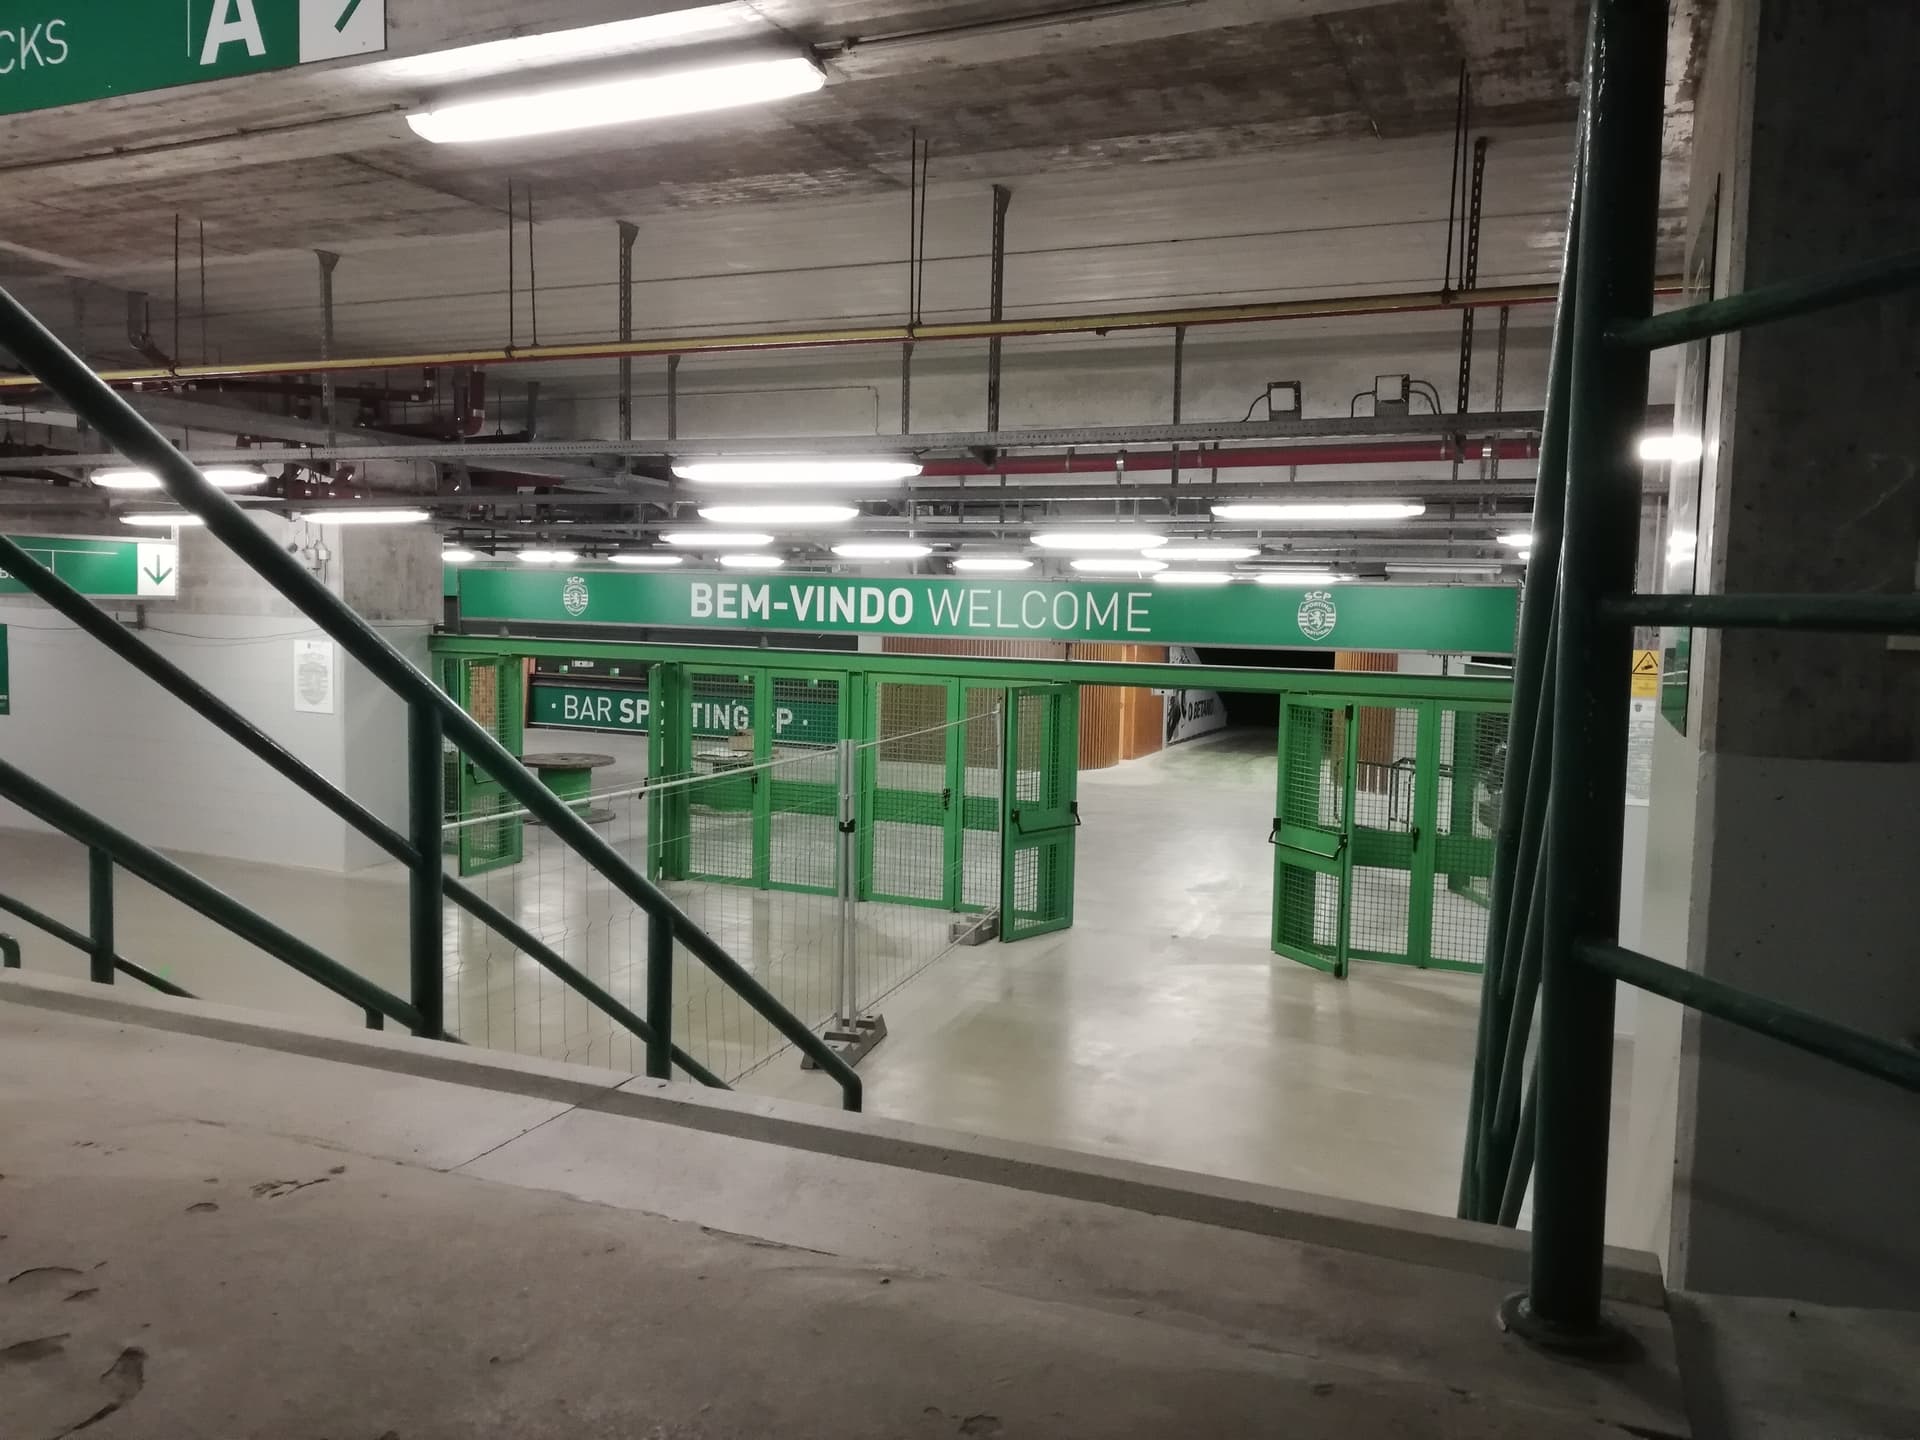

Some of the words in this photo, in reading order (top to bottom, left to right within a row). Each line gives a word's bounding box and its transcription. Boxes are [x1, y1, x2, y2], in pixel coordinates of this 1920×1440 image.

[199, 0, 266, 65] A
[690, 582, 914, 625] BEM-VINDO
[927, 588, 1153, 632] WELCOME
[1304, 590, 1332, 601] SCP
[564, 694, 612, 722] BAR
[619, 698, 749, 730] SPTING
